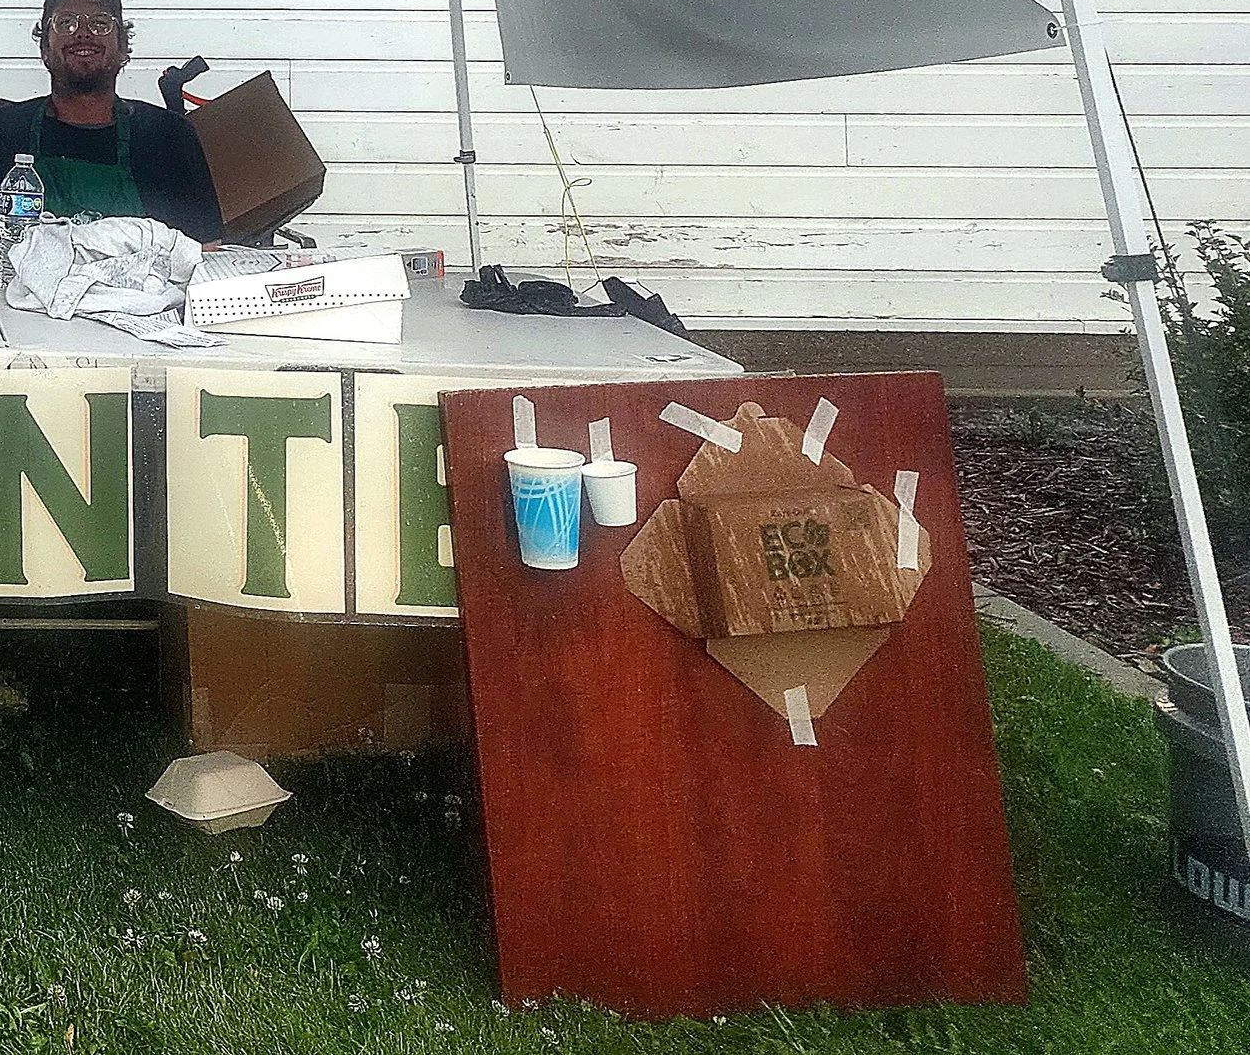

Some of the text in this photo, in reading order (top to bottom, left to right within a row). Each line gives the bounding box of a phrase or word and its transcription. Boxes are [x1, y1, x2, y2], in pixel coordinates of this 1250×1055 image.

[271, 286, 297, 299] Krispy
[296, 284, 322, 295] Kreme
[766, 548, 835, 581] BOX
